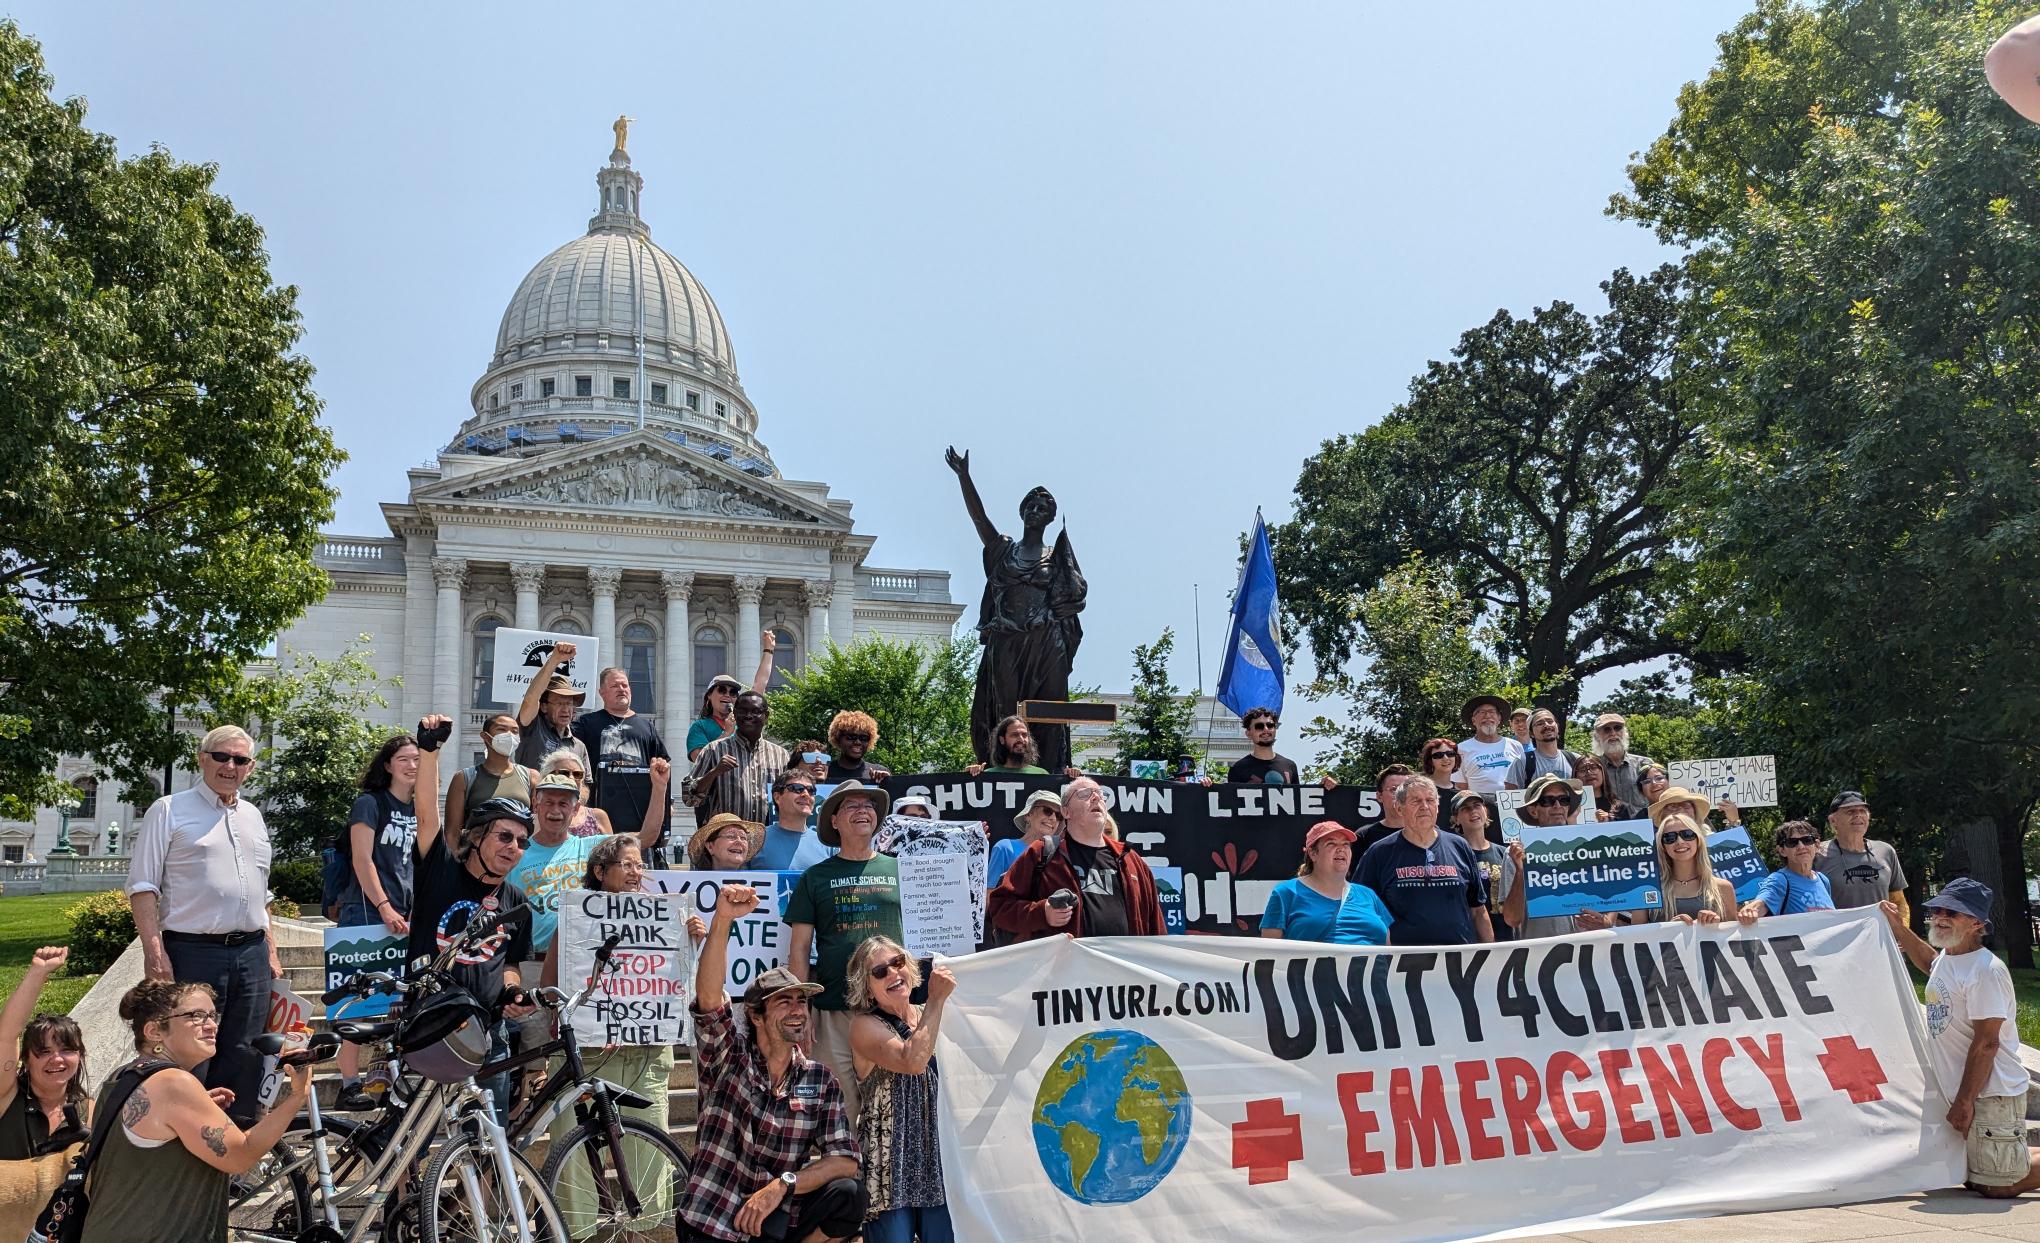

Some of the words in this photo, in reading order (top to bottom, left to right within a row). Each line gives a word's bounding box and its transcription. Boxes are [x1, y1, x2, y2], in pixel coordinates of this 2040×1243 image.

[522, 639, 553, 656] VETERANS
[1491, 751, 1505, 759] LINE
[1670, 759, 1728, 780] SYSTEM
[1731, 755, 1774, 776] CHANGE
[905, 781, 1025, 811] SHUT
[1208, 787, 1326, 818] LINE
[1358, 790, 1382, 818] 5
[1728, 777, 1777, 803] CHANGE
[920, 839, 948, 854] HONOR
[1526, 850, 1574, 865] Protect
[1576, 848, 1602, 861] Our
[1604, 845, 1653, 859] Waters
[1709, 846, 1753, 863] Waters
[521, 861, 588, 884] CLIMATE
[925, 873, 945, 881] getting
[1527, 868, 1589, 890] Reject
[1592, 864, 1633, 883] Line
[1637, 861, 1656, 879] 5!
[1713, 866, 1743, 880] ine
[1743, 857, 1763, 874] 5!
[525, 875, 581, 897] ACTIO
[830, 876, 858, 888] CLIMATE
[858, 876, 887, 886] SCIENCE
[582, 893, 670, 921] CHASE
[1158, 891, 1181, 903] ters
[1167, 909, 1183, 927] 5!
[919, 934, 938, 942] power
[329, 950, 382, 965] Protect
[385, 947, 409, 960] Ou
[601, 952, 666, 976] TOP
[596, 1000, 677, 1023] FOSSIL
[1336, 1032, 1803, 1177] EMERGENCY
